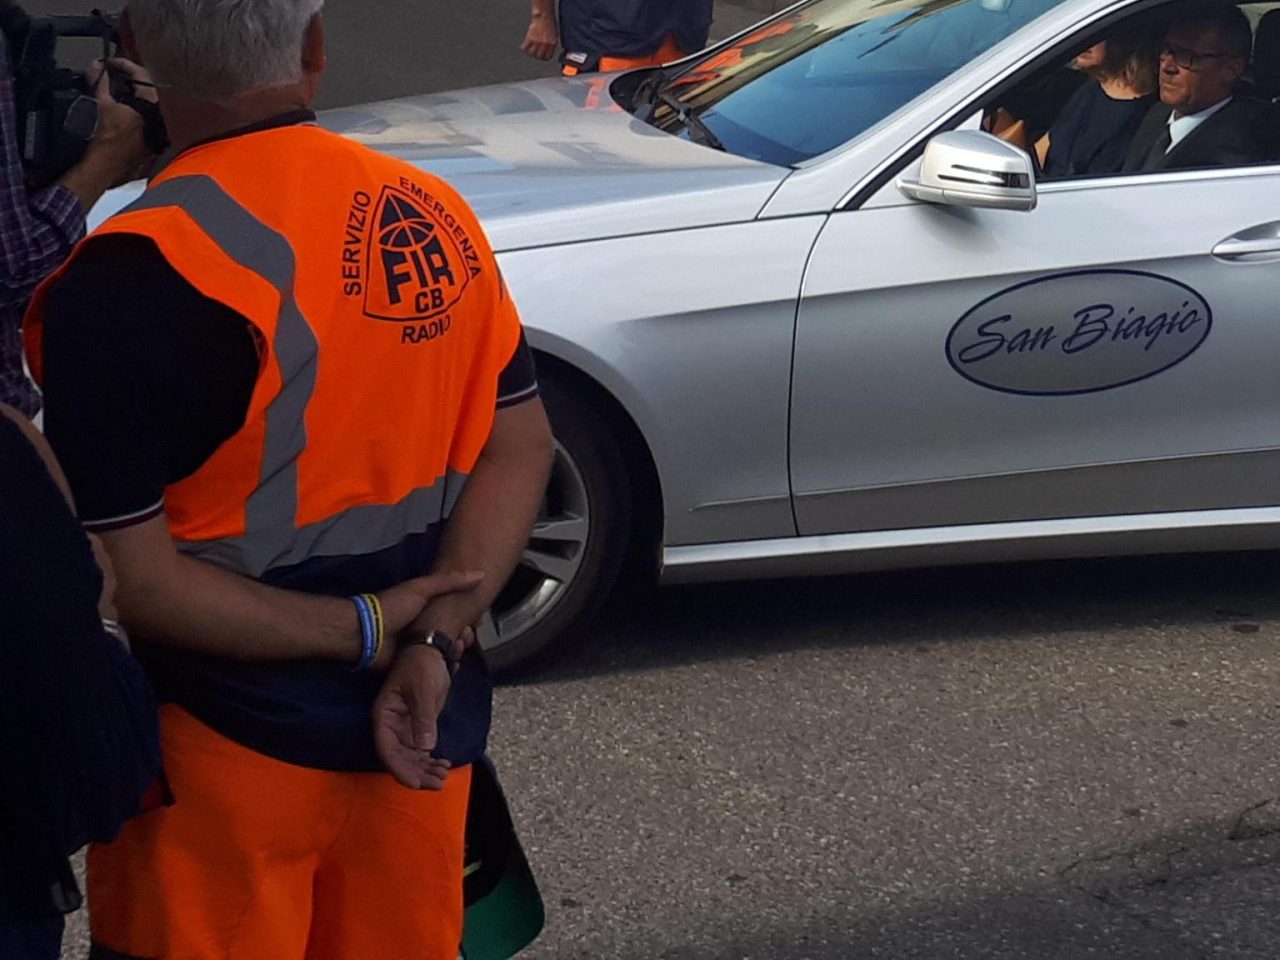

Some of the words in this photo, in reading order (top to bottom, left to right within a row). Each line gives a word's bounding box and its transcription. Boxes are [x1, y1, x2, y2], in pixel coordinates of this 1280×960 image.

[342, 191, 371, 297] SERVIZIO
[400, 176, 482, 280] EMERGENZA
[380, 234, 455, 305] FIR
[415, 288, 444, 313] CB
[401, 314, 451, 344] RADIO
[958, 314, 1056, 364] San
[1061, 300, 1203, 355] Biagio
